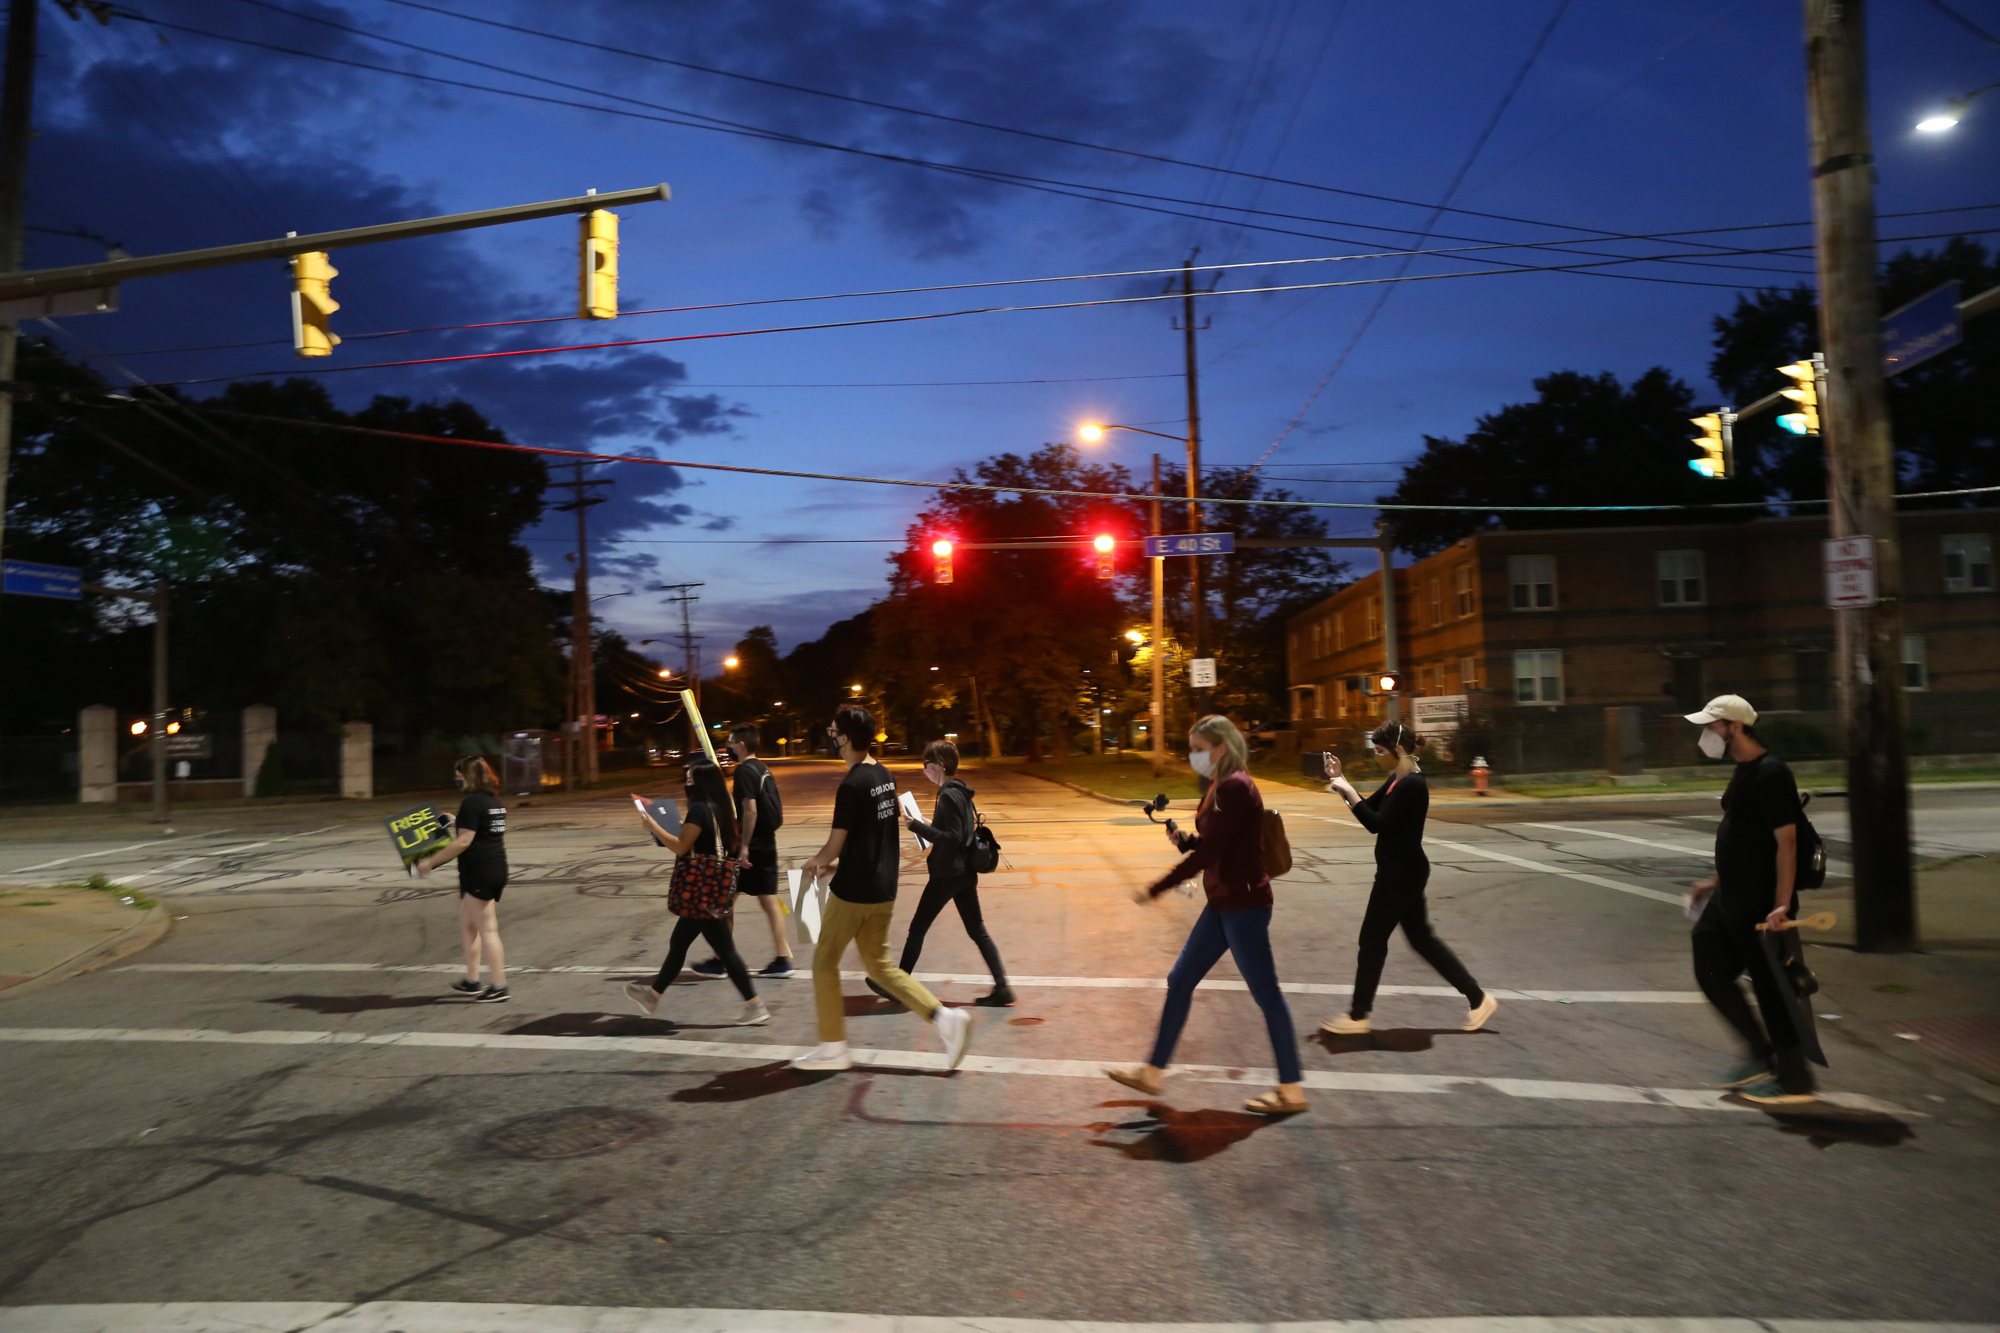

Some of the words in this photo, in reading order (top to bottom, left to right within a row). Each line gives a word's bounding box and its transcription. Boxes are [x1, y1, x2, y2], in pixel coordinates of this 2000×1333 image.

[1175, 538, 1198, 552] 40
[1200, 537, 1222, 551] St
[1196, 672, 1212, 684] 35
[390, 807, 435, 833] RISE
[397, 821, 438, 849] UP
